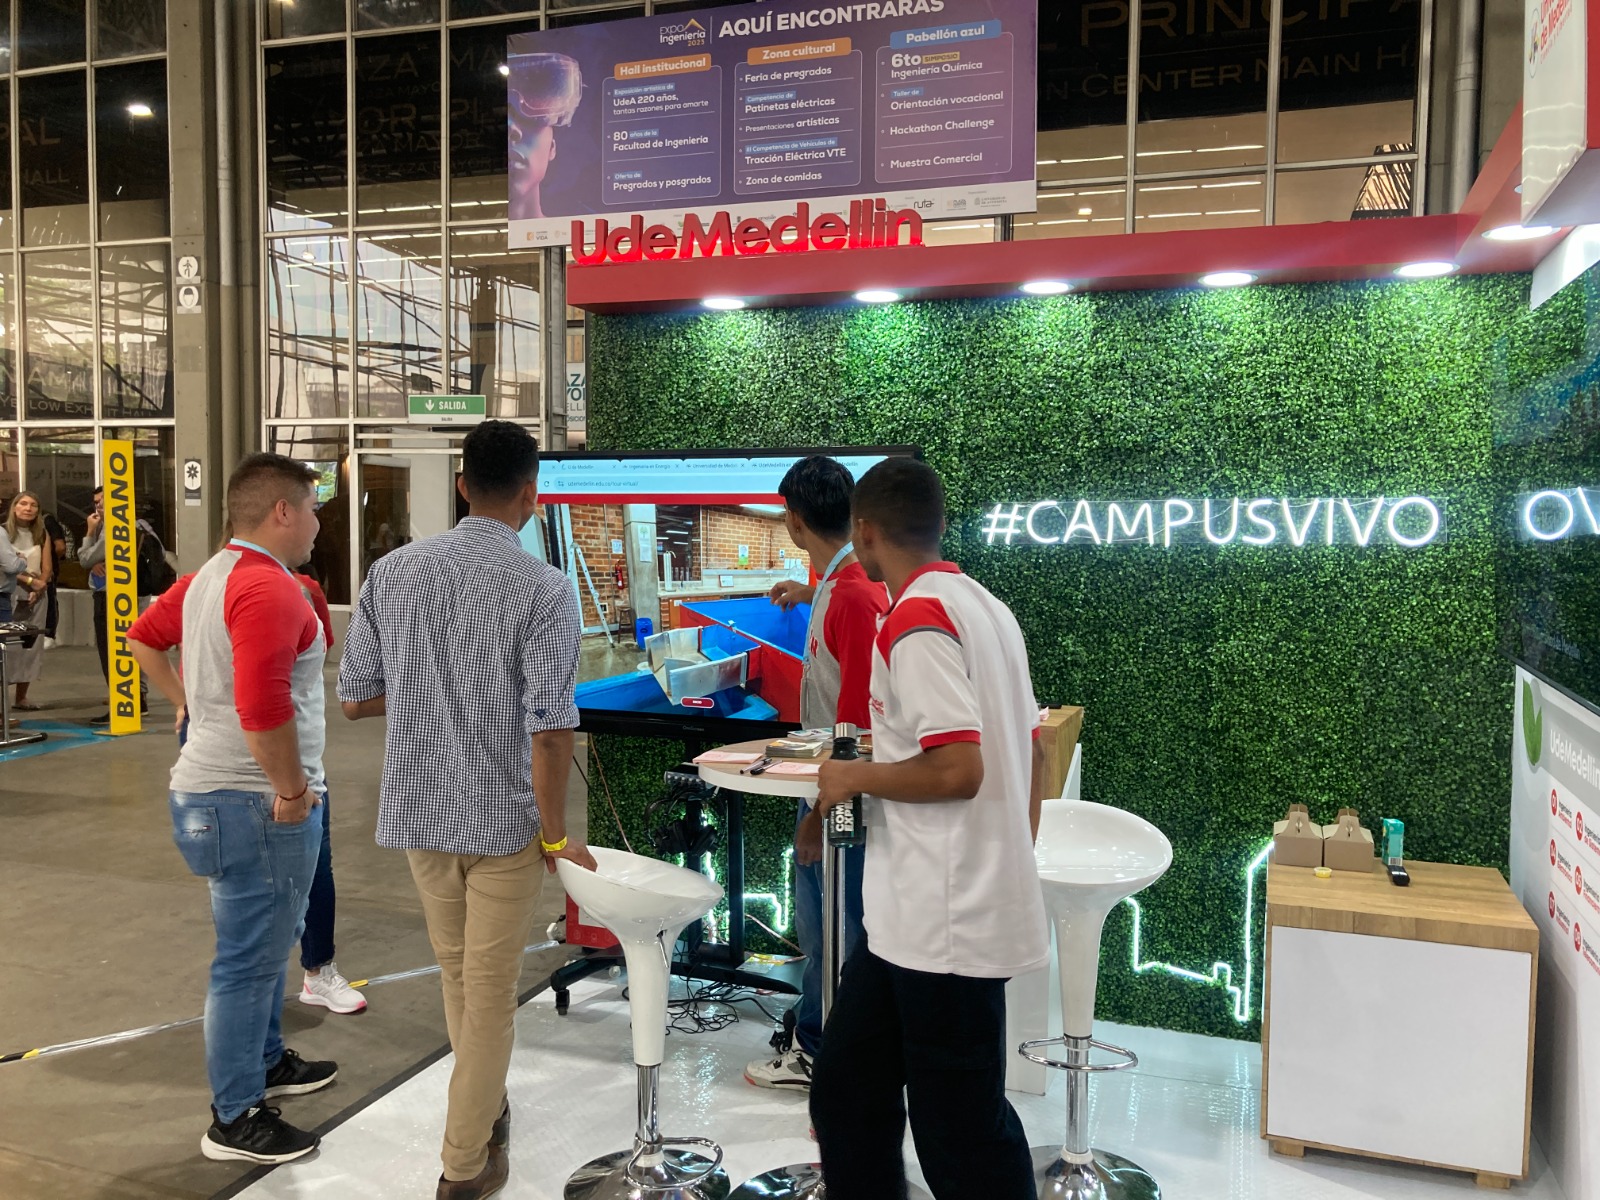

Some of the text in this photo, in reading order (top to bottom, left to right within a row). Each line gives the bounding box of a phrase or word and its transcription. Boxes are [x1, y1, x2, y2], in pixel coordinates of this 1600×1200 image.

[719, 11, 772, 38] AQUÍ
[906, 25, 985, 43] Pabellón azul
[762, 43, 836, 60] Zona cultural
[620, 58, 706, 76] Hall institucional
[891, 53, 921, 68] 6to
[745, 66, 832, 83] Feria de pregrados
[891, 62, 983, 80] Ingeniería Química
[613, 97, 637, 108] UdeA
[637, 95, 655, 105] 220
[613, 100, 709, 116] tantas razones para amarte
[745, 98, 836, 114] Patinetas eléctricas
[890, 91, 1004, 110] Orientación vocacional
[745, 116, 840, 134] Presentaciones artísticas
[890, 119, 995, 136] Hackathon Challenge
[613, 131, 628, 142] 80
[613, 136, 709, 152] Facultad de Ingeniería
[752, 143, 790, 153] Competencia
[800, 138, 827, 147] Vehículos
[745, 148, 847, 165] Tracción Eléctrica VTE
[890, 152, 983, 169] Muestra Comercial
[613, 176, 712, 193] Pregrados y posgrados
[746, 171, 822, 186] Zona de comidas
[571, 197, 924, 265] UdeMedellin
[438, 401, 467, 410] SALIDA
[981, 495, 1443, 547] #CAMPUSVIVO
[109, 452, 135, 718] BACHEO URBANO
